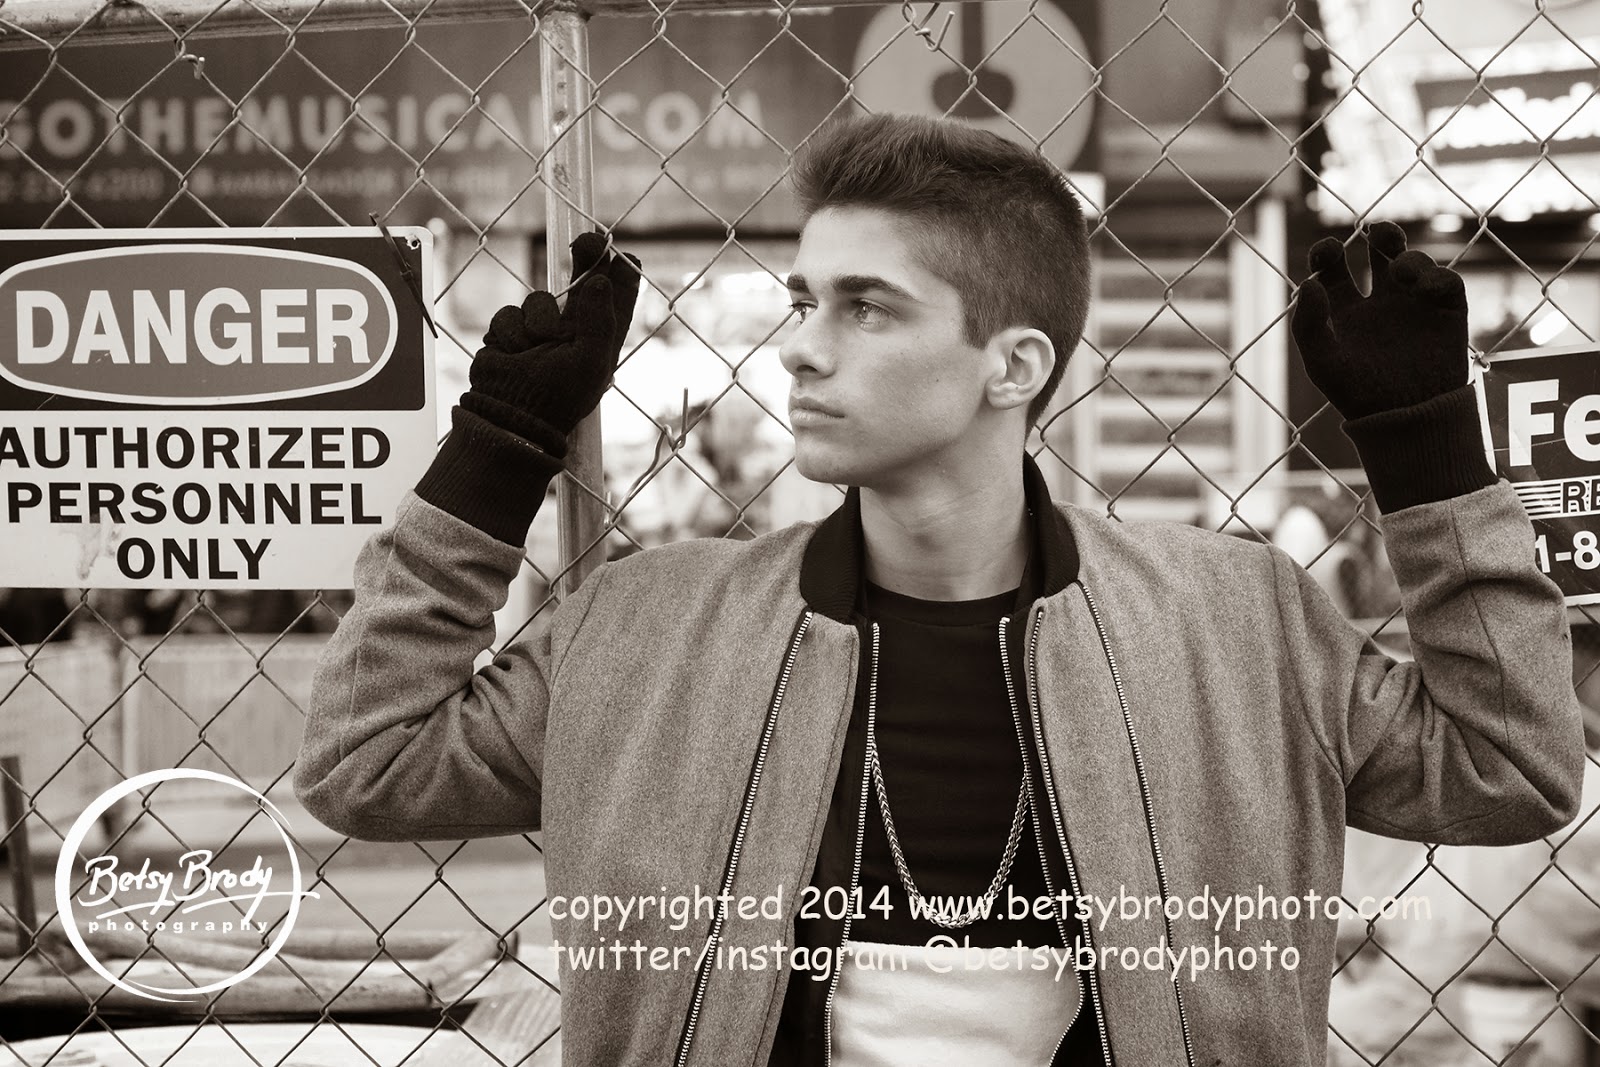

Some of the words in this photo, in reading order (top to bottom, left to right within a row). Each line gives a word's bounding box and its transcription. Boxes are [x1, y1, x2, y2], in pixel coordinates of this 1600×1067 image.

[16, 287, 371, 366] DANGER
[0, 427, 391, 470] AUTHORIZED
[7, 482, 382, 524] PERSONNEL
[117, 537, 272, 580] ONLY
